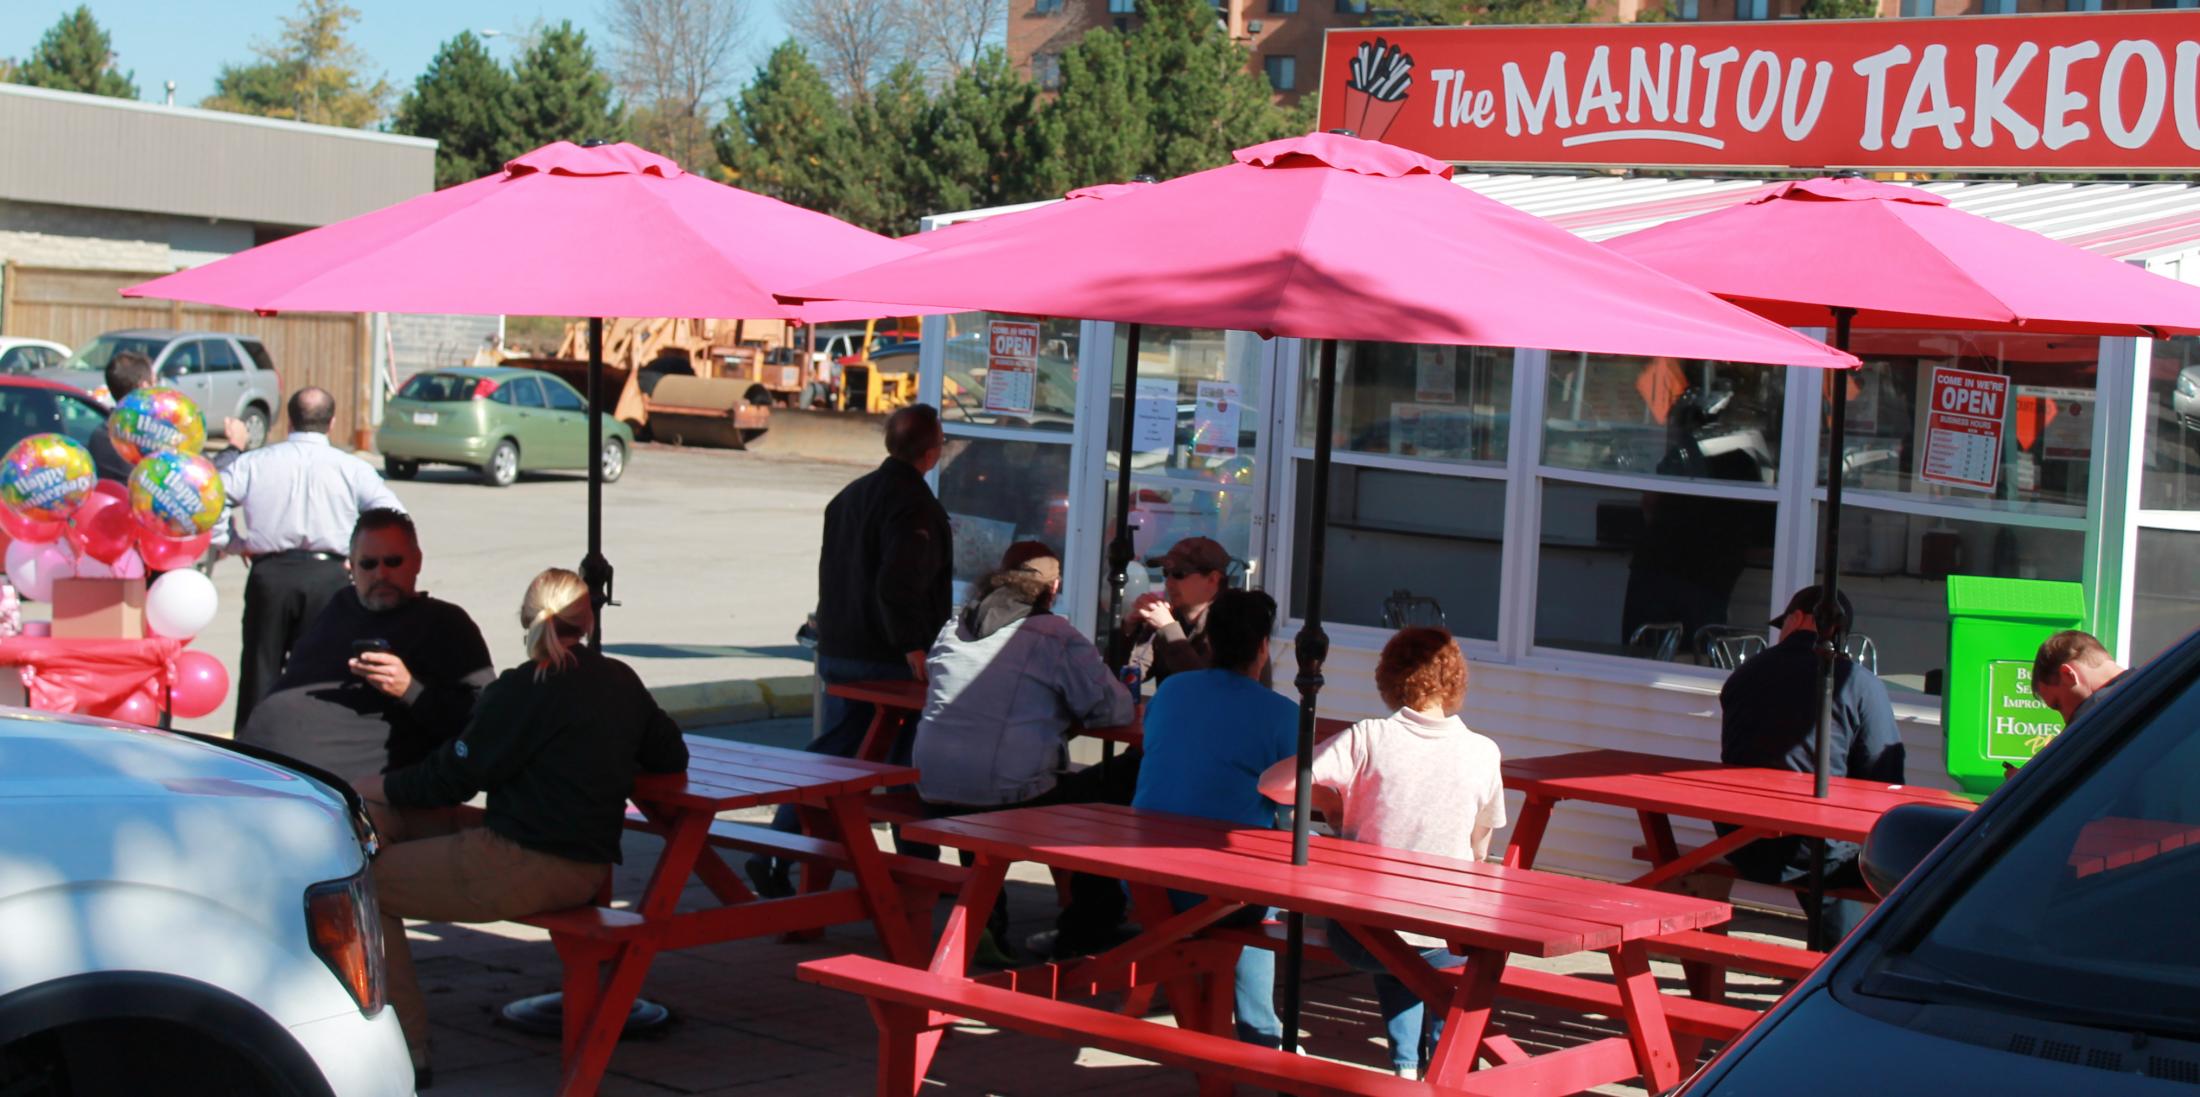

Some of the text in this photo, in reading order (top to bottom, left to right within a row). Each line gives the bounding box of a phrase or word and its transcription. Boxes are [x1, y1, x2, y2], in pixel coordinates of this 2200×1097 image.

[1431, 69, 1495, 128] The
[1502, 42, 1833, 141] MANITOU
[996, 335, 1032, 356] OPEN
[1937, 375, 2004, 392] COME IN WE'RE
[1942, 386, 1997, 415] OPEN
[2017, 667, 2033, 680] BU
[2015, 681, 2033, 694] SE
[2003, 695, 2049, 709] IMPROV
[1996, 716, 2061, 736] HOMES
